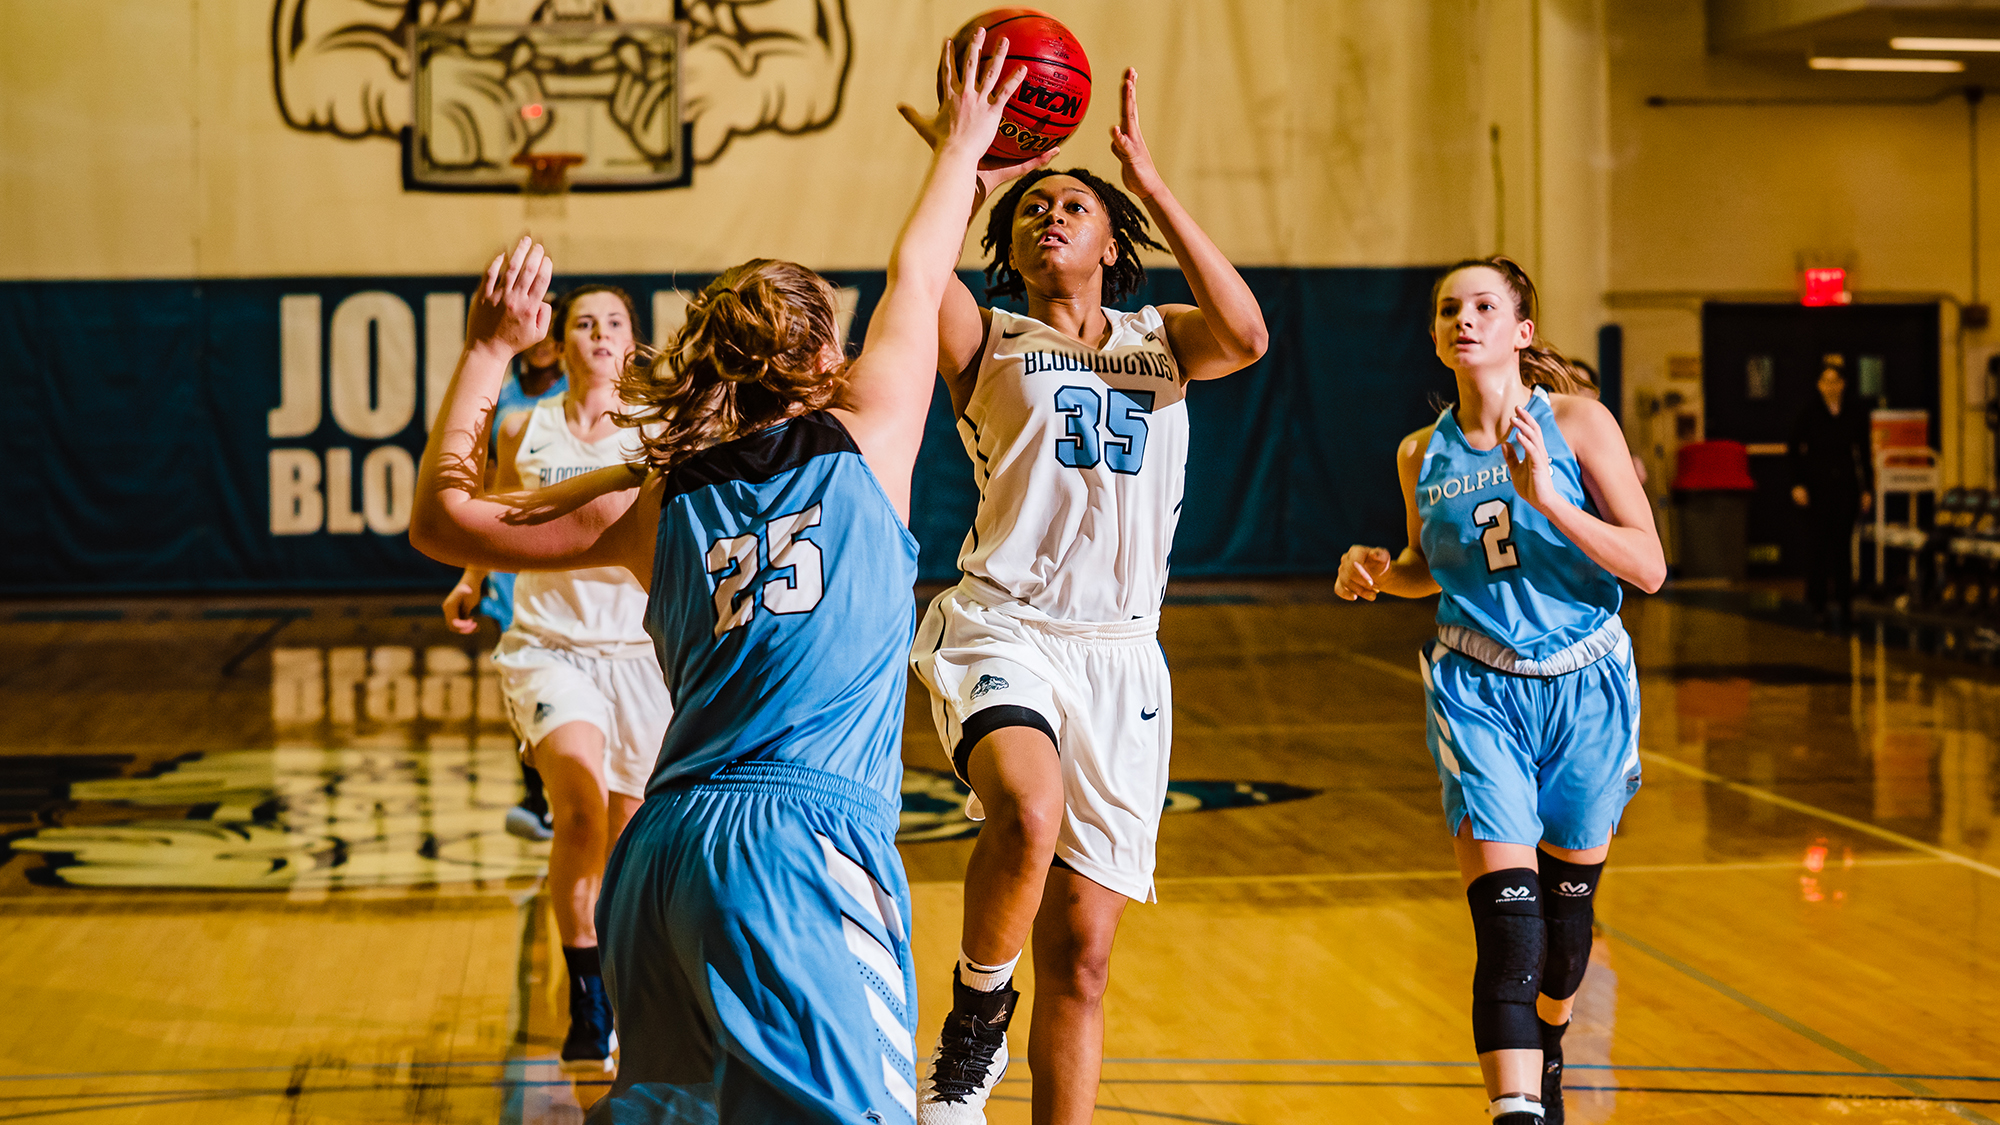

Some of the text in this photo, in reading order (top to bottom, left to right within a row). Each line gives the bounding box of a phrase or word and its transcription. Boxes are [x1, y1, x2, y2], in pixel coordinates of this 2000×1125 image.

[1017, 79, 1083, 119] NCAA
[999, 116, 1069, 152] Wilso
[1024, 350, 1174, 382] BLOODHOUNDS
[1053, 384, 1156, 476] 35
[1472, 497, 1521, 575] 2
[705, 499, 825, 644] 25
